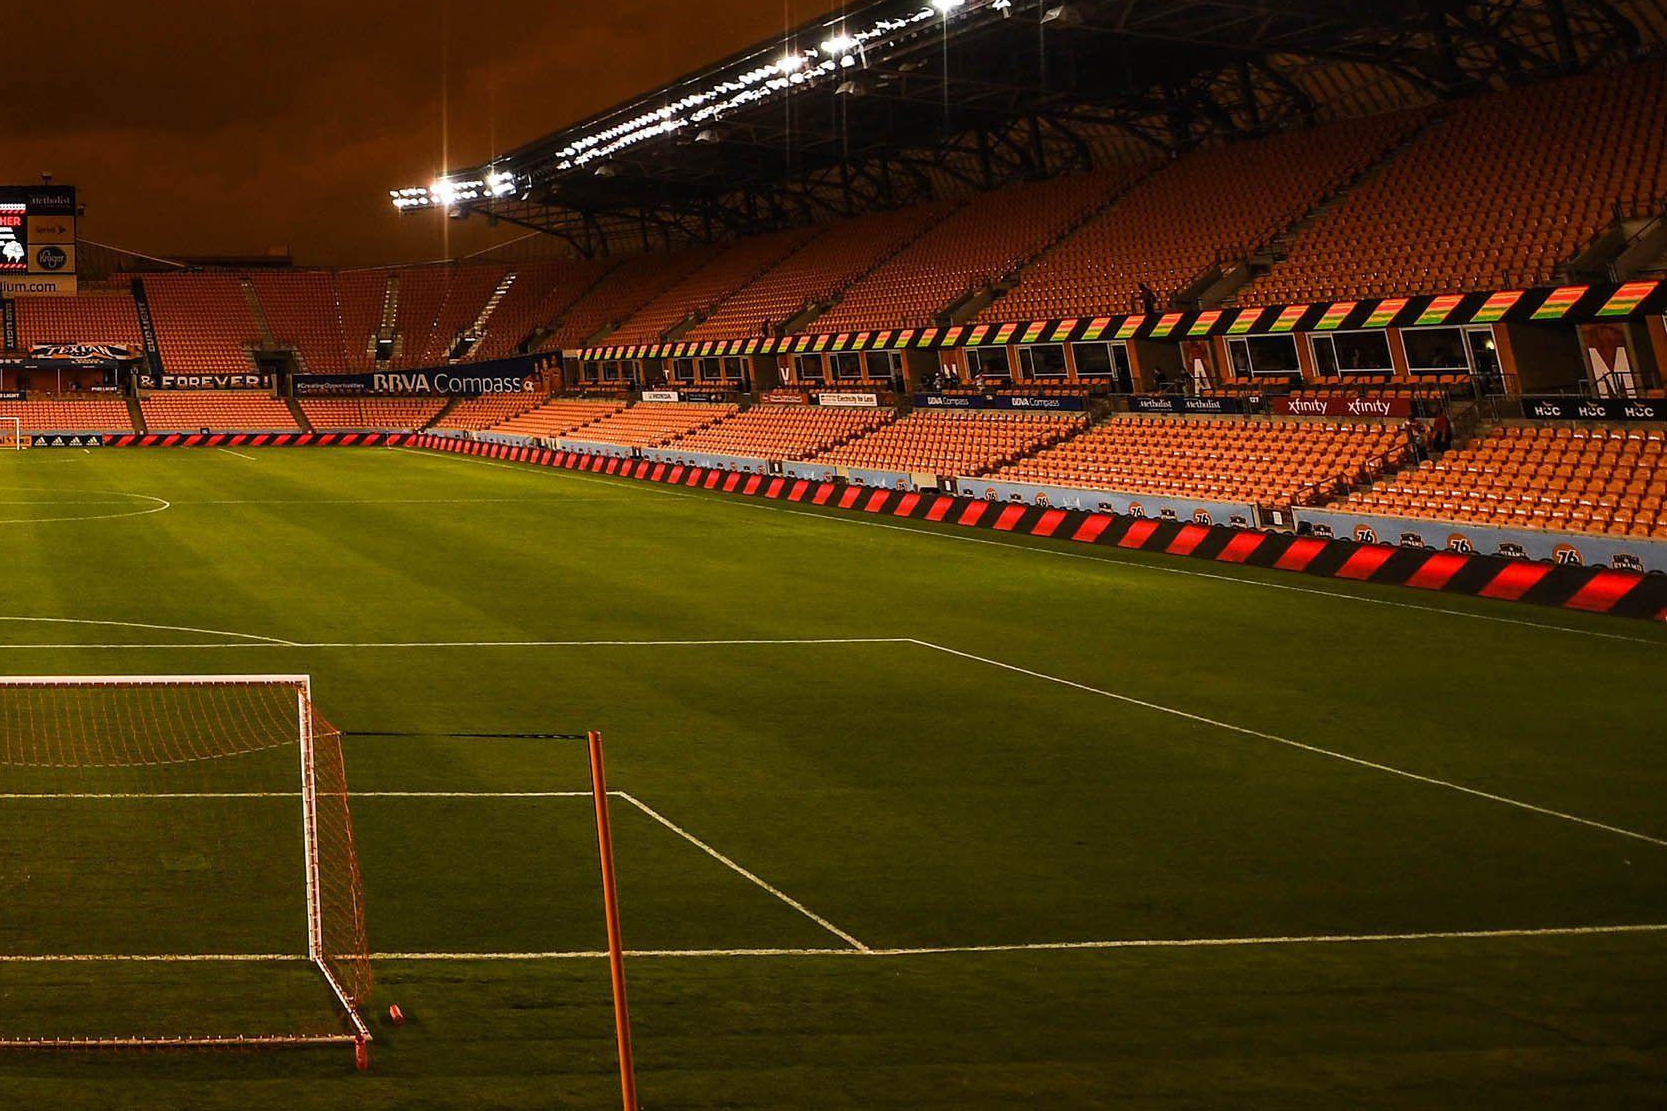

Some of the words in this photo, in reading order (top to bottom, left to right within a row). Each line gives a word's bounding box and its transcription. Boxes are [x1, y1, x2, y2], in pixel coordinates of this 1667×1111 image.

[39, 250, 64, 268] Kroger
[374, 374, 430, 391] BBVA
[434, 374, 521, 393] Compass
[943, 397, 969, 406] Compass
[1029, 398, 1059, 407] Compass
[1138, 399, 1172, 408] Methodist
[1185, 399, 1220, 408] Methodist
[1288, 398, 1327, 414] xfinity
[1348, 398, 1390, 415] xfinity
[1131, 507, 1143, 517] 76
[1195, 512, 1209, 524] 76
[1357, 529, 1376, 544] 76
[1451, 540, 1470, 553] 76
[1556, 549, 1580, 565] 76
